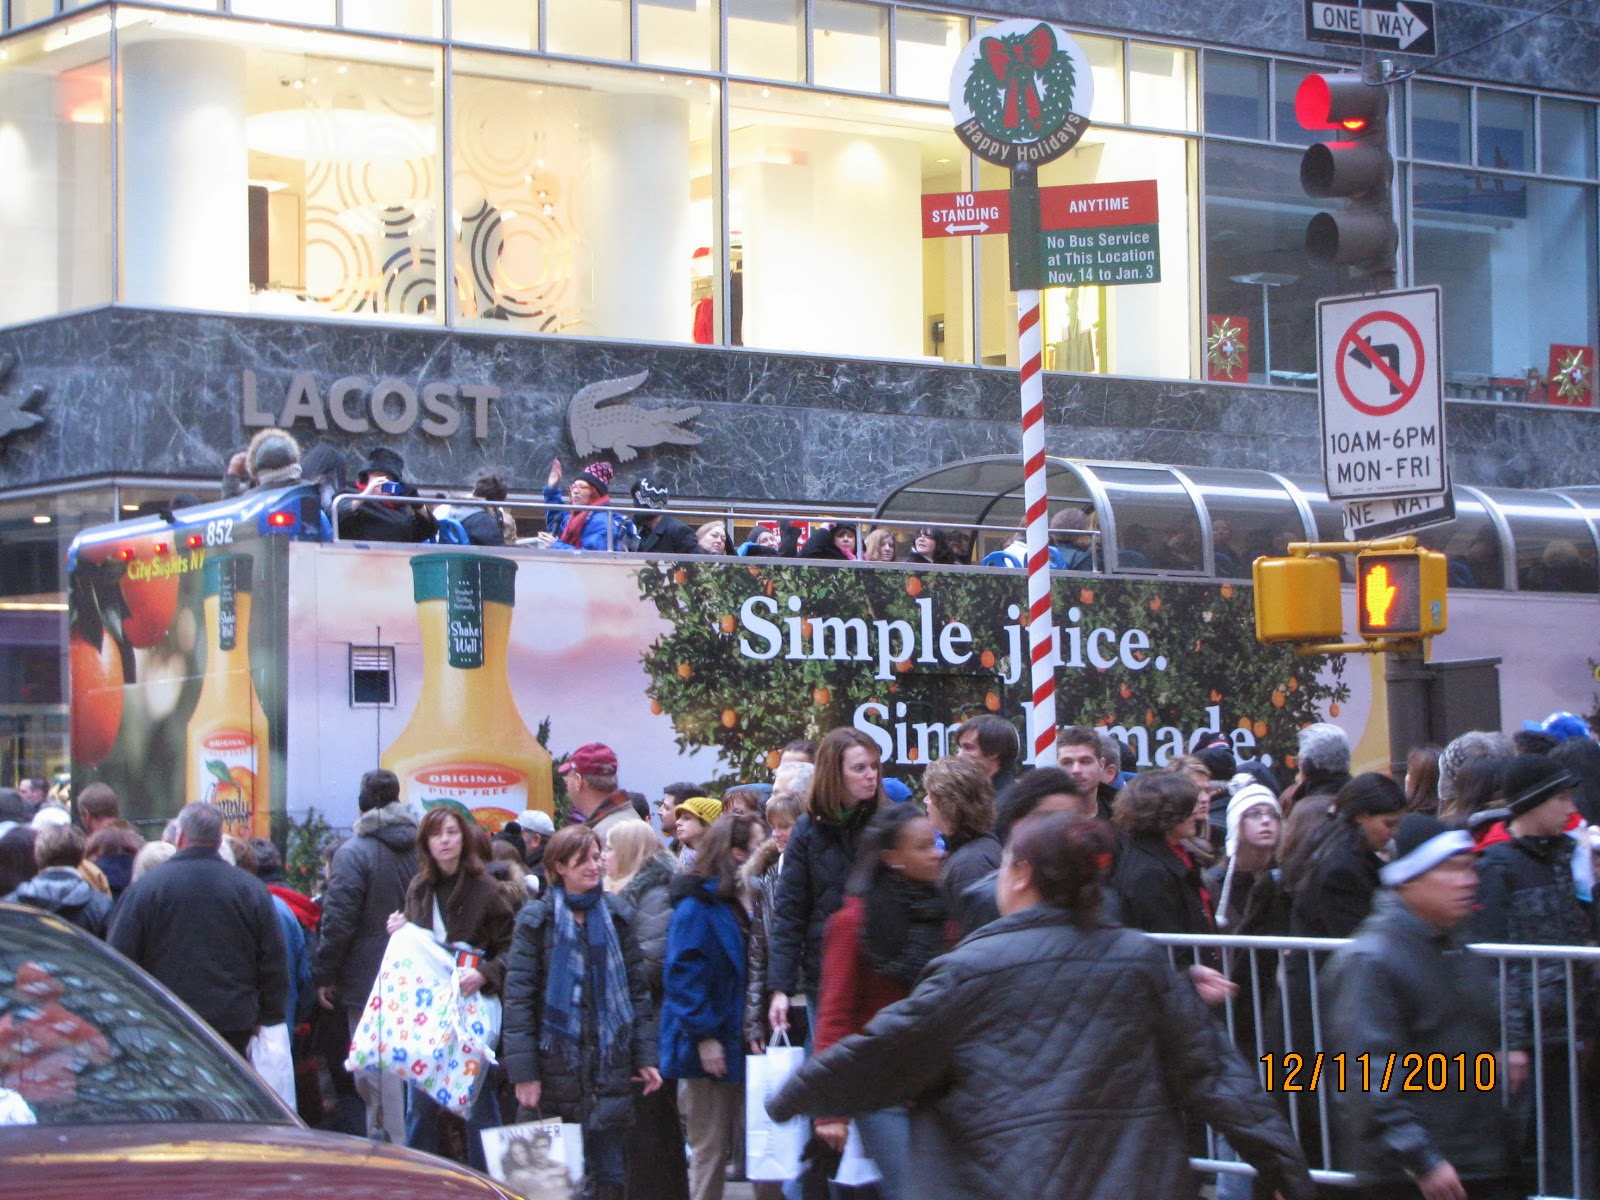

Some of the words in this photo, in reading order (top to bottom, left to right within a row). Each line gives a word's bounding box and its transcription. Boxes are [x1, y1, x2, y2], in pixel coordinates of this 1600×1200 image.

[1323, 7, 1360, 30] ONE
[1376, 13, 1415, 36] WAY
[962, 120, 1010, 160] Happy
[1017, 114, 1080, 161] Holidays
[956, 194, 975, 208] NO
[1069, 197, 1130, 214] ANYTIME
[932, 206, 999, 223] STANDING
[1047, 236, 1065, 249] No
[1069, 234, 1094, 248] Bus
[1098, 231, 1150, 247] Service
[1047, 253, 1061, 266] at
[1064, 251, 1093, 265] This
[1097, 248, 1155, 264] Location
[1048, 270, 1076, 283] Nov.
[1079, 267, 1094, 282] 14
[1099, 268, 1112, 281] to
[1116, 267, 1143, 280] Jan.
[1146, 264, 1154, 279] 3
[243, 370, 500, 438] LACOST
[1330, 425, 1436, 455] 10AM-6PM
[206, 518, 234, 547] 852
[450, 621, 479, 637] Shake
[740, 595, 974, 681] Simple
[453, 637, 477, 654] Well
[853, 701, 1077, 768] Siml
[428, 774, 507, 784] ORIGINAL
[428, 786, 467, 797] PULP
[473, 785, 509, 797] FREE
